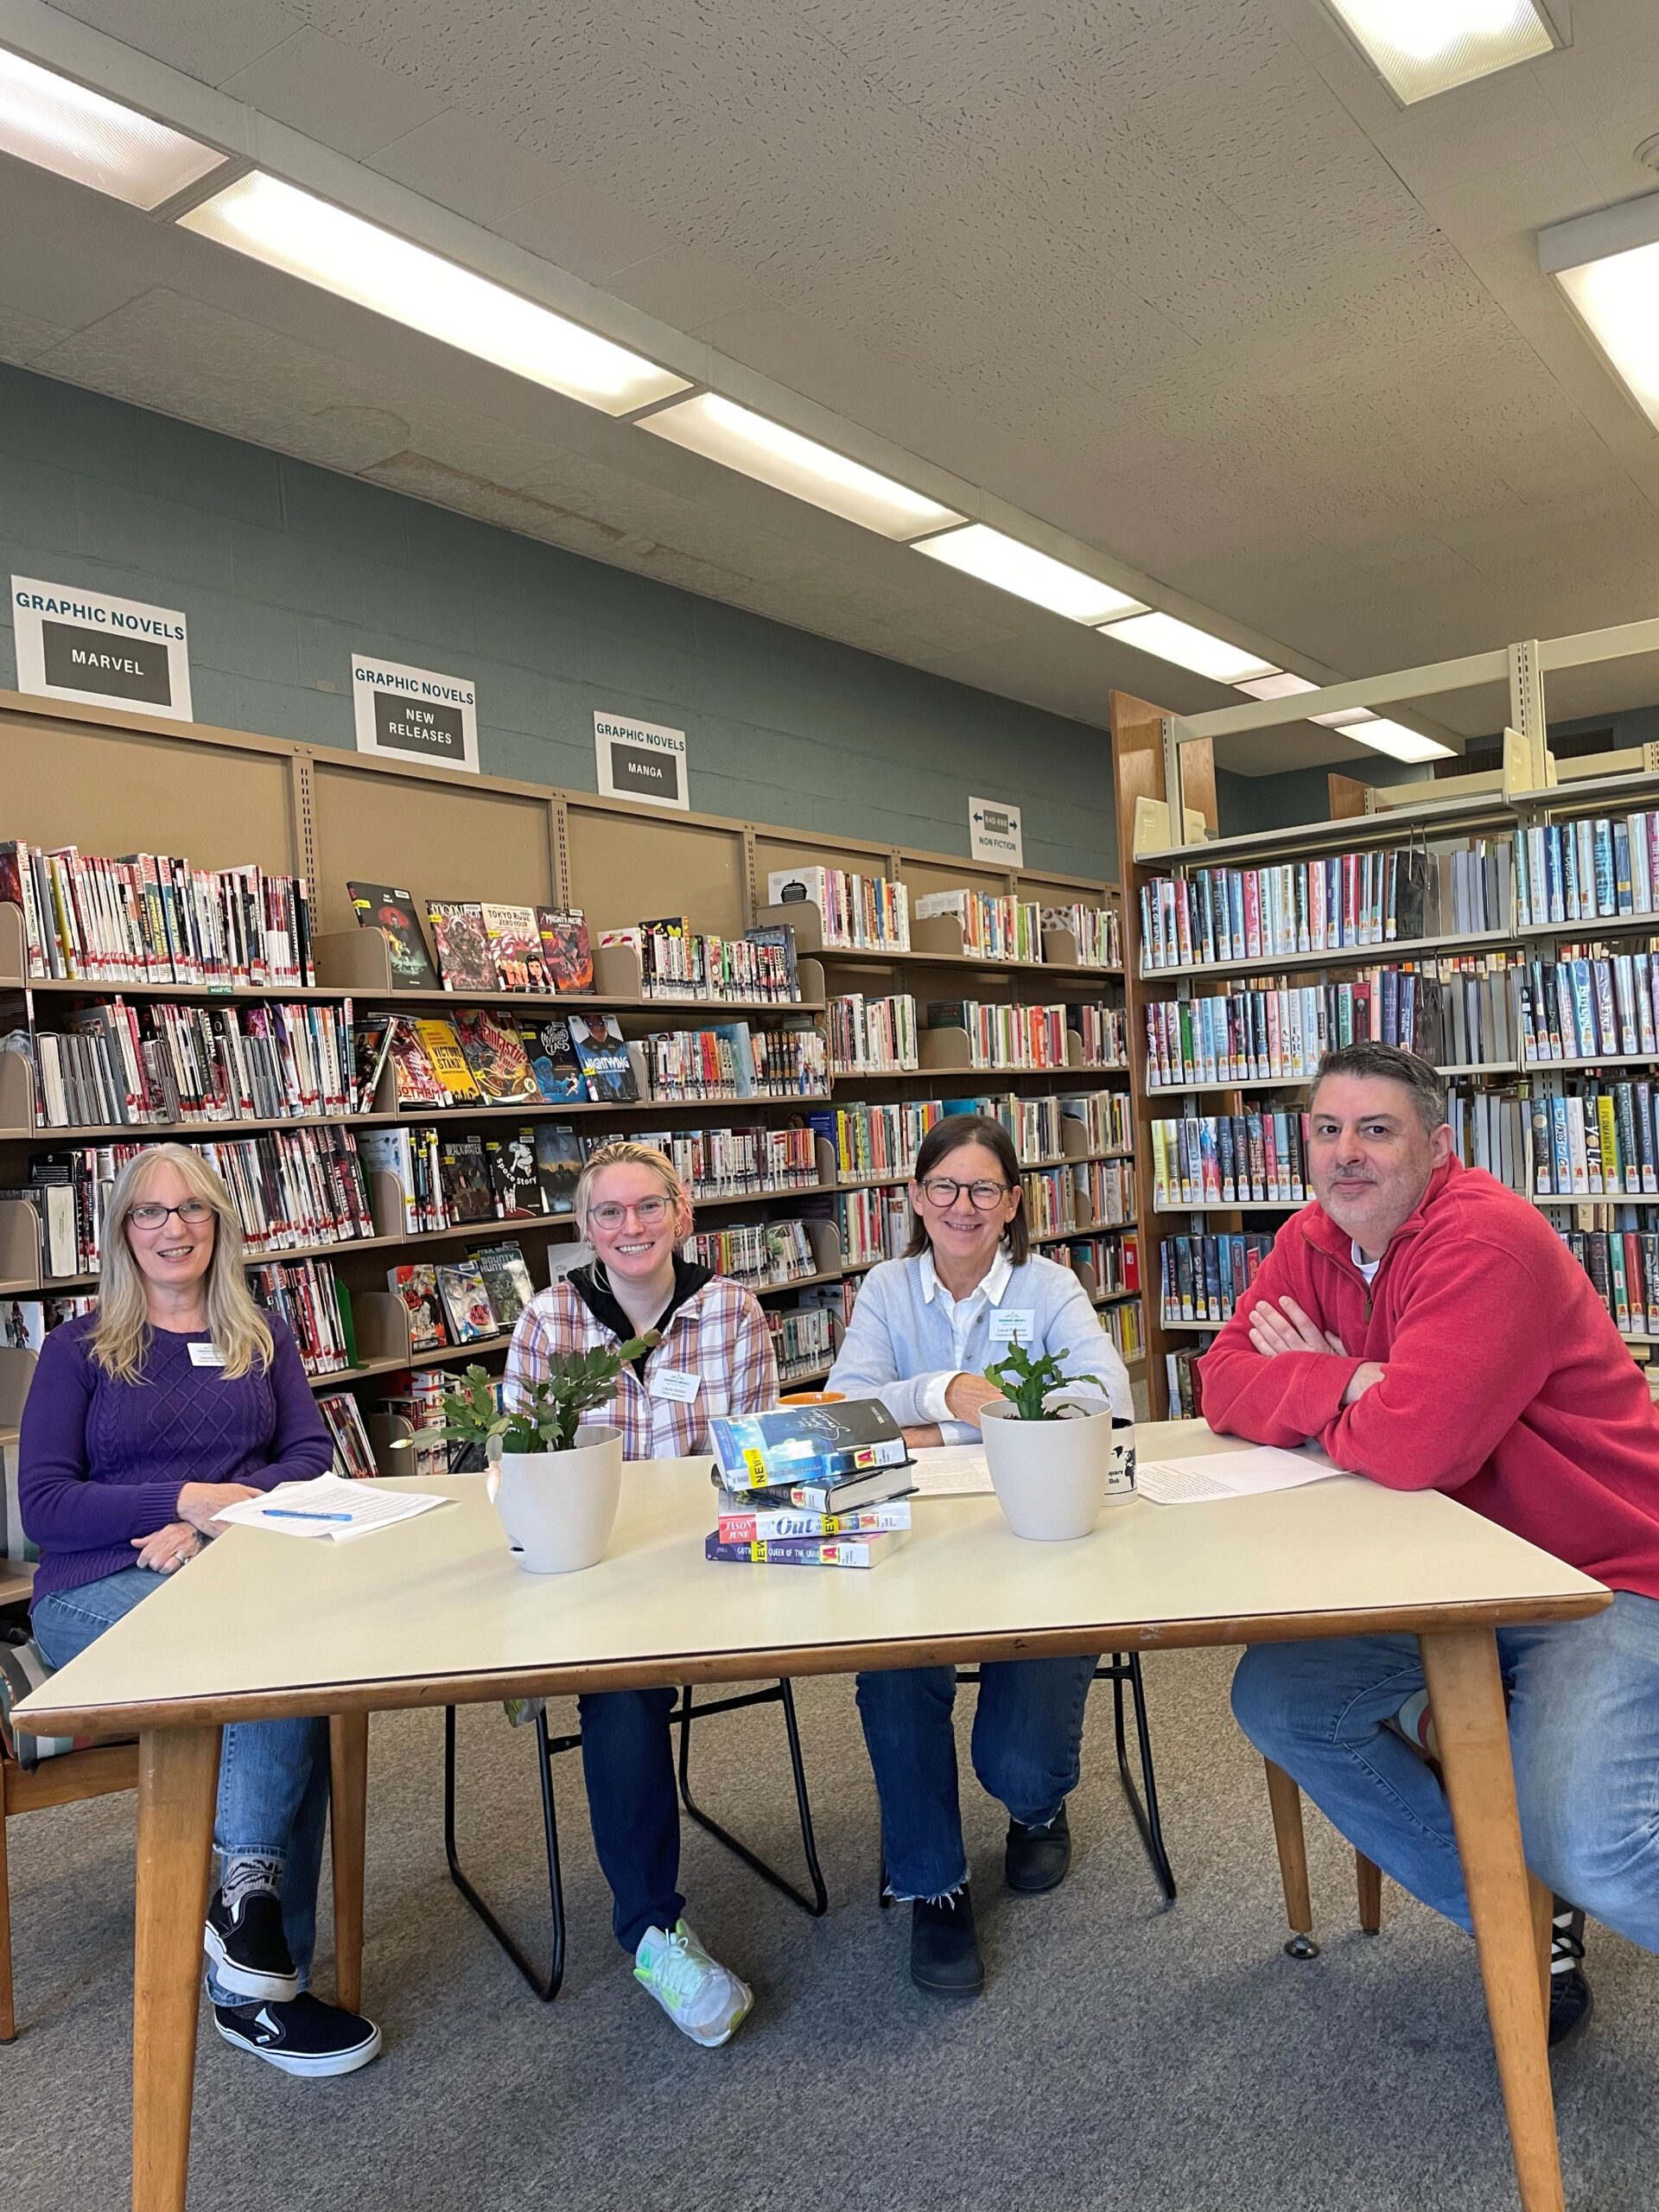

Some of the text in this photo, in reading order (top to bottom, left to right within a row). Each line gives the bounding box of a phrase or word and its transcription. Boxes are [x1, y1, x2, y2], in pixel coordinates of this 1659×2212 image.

[16, 592, 185, 640] GRAPHIC NOVELS
[72, 649, 144, 676] MARVEL
[355, 668, 474, 705] GRAPHIC NOVELS
[406, 708, 435, 724] NEW
[389, 722, 452, 745] RELEASES
[596, 722, 685, 752] GRAPHIC NOVELS
[628, 762, 663, 779] MANGA
[979, 836, 1016, 851] NON FICTION
[487, 910, 512, 919] TOKYO
[499, 918, 513, 927] ZERO
[204, 1017, 216, 1057] ESSENTIAL
[544, 1040, 570, 1056] CLASS
[584, 1056, 631, 1070] NIGHTWING
[1602, 1110, 1612, 1154] PERMANENT
[446, 1143, 482, 1156] BLACKWATER
[497, 1158, 516, 1182] Space
[517, 1176, 537, 1185] Story
[329, 1174, 340, 1207] PUNISHER
[338, 1179, 349, 1212] PUNISHER
[353, 1179, 364, 1213] PUNISHER
[481, 1254, 514, 1264] BOUNTY
[480, 1264, 504, 1273] HUNT
[753, 1459, 766, 1484] NEW
[768, 1487, 789, 1499] WILD
[726, 1521, 753, 1531] JASON
[777, 1516, 813, 1535] Out
[728, 1531, 750, 1540] JUNE
[768, 1548, 785, 1556] QUEEN
